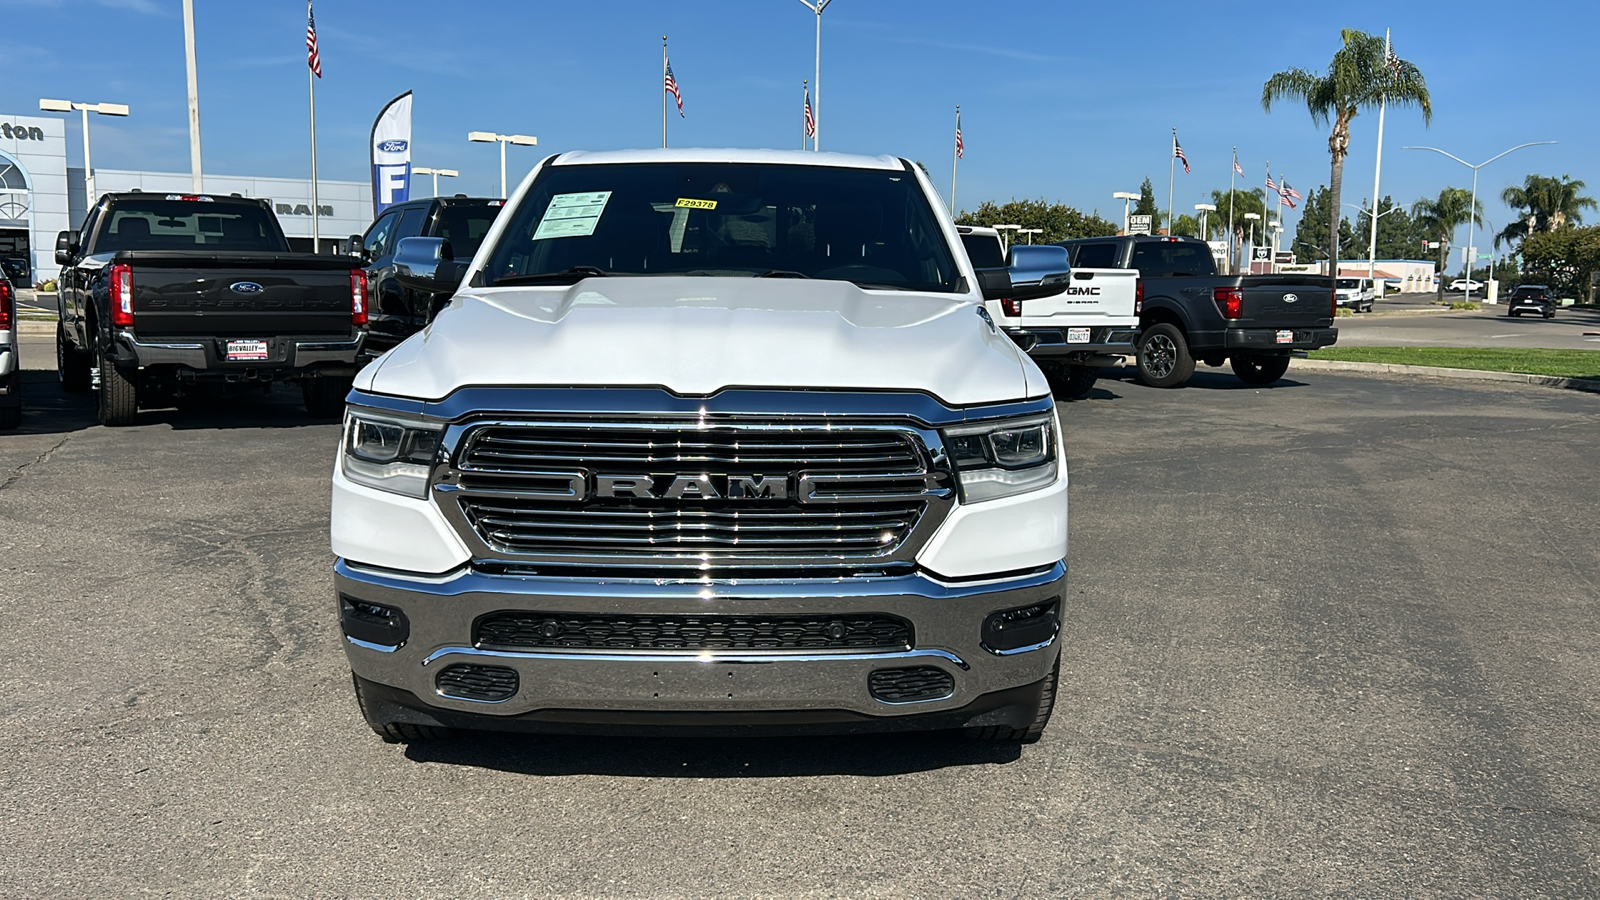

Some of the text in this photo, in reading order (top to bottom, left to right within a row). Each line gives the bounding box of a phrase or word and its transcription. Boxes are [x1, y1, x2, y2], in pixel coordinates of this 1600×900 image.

[0, 122, 44, 141] ton
[383, 141, 406, 152] Ford
[379, 165, 406, 204] F
[275, 203, 334, 217] RAM
[677, 199, 715, 209] F29378
[1130, 215, 1150, 224] OEM
[1066, 286, 1101, 296] GMC
[596, 474, 788, 499] RAM
